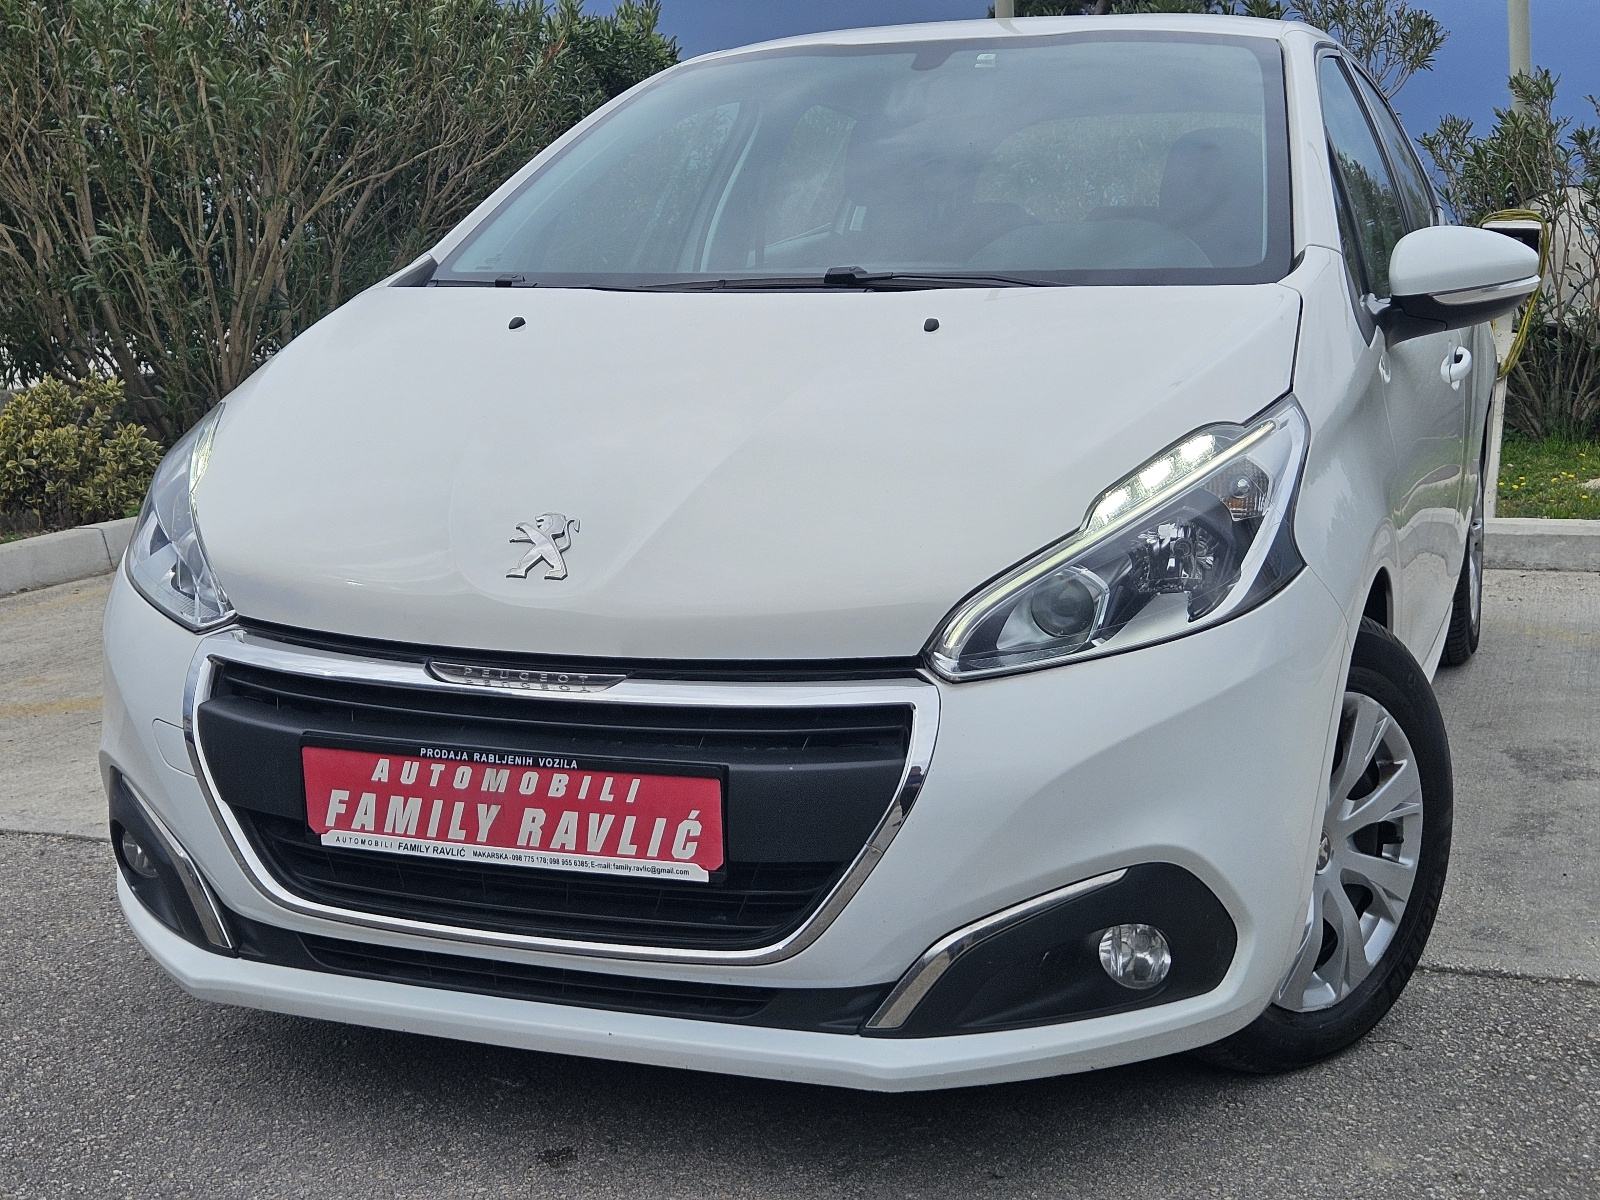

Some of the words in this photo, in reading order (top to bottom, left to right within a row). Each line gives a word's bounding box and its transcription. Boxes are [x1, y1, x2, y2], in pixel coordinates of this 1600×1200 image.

[420, 747, 469, 761] PRODAJA
[473, 752, 533, 766] RABLJENIH
[538, 757, 578, 769] VOZILA
[371, 758, 641, 803] AUTOMOBILI
[325, 789, 502, 843] FAMILY
[516, 809, 703, 860] RAVLIĆ
[335, 836, 394, 849] AUTOMOBILI
[398, 842, 431, 854] FAMILY
[432, 846, 467, 858] RAVLIĆ
